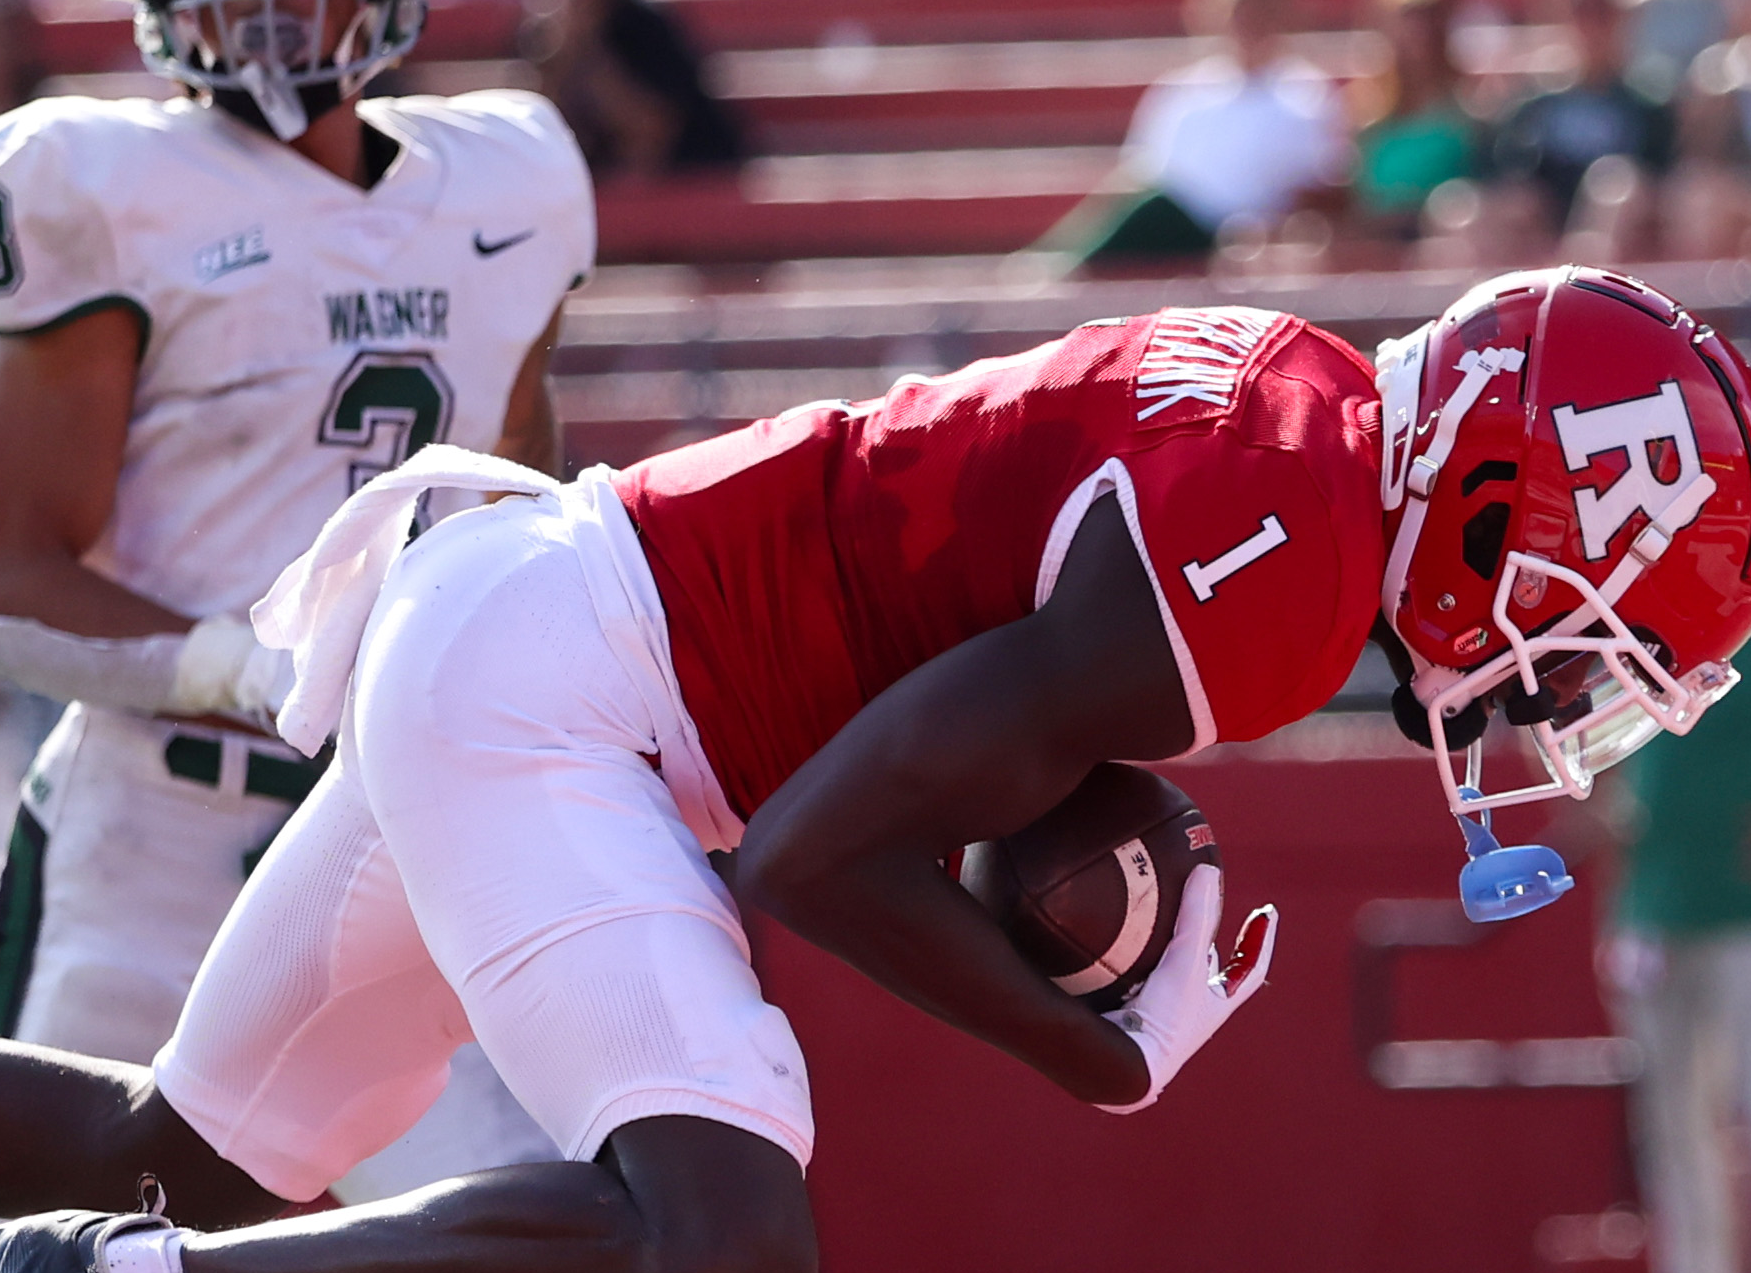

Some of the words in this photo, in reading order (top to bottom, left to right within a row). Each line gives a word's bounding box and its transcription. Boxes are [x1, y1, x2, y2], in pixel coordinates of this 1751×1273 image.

[323, 286, 450, 344] WAGNER
[1549, 377, 1714, 564] R
[1178, 510, 1290, 607] 1
